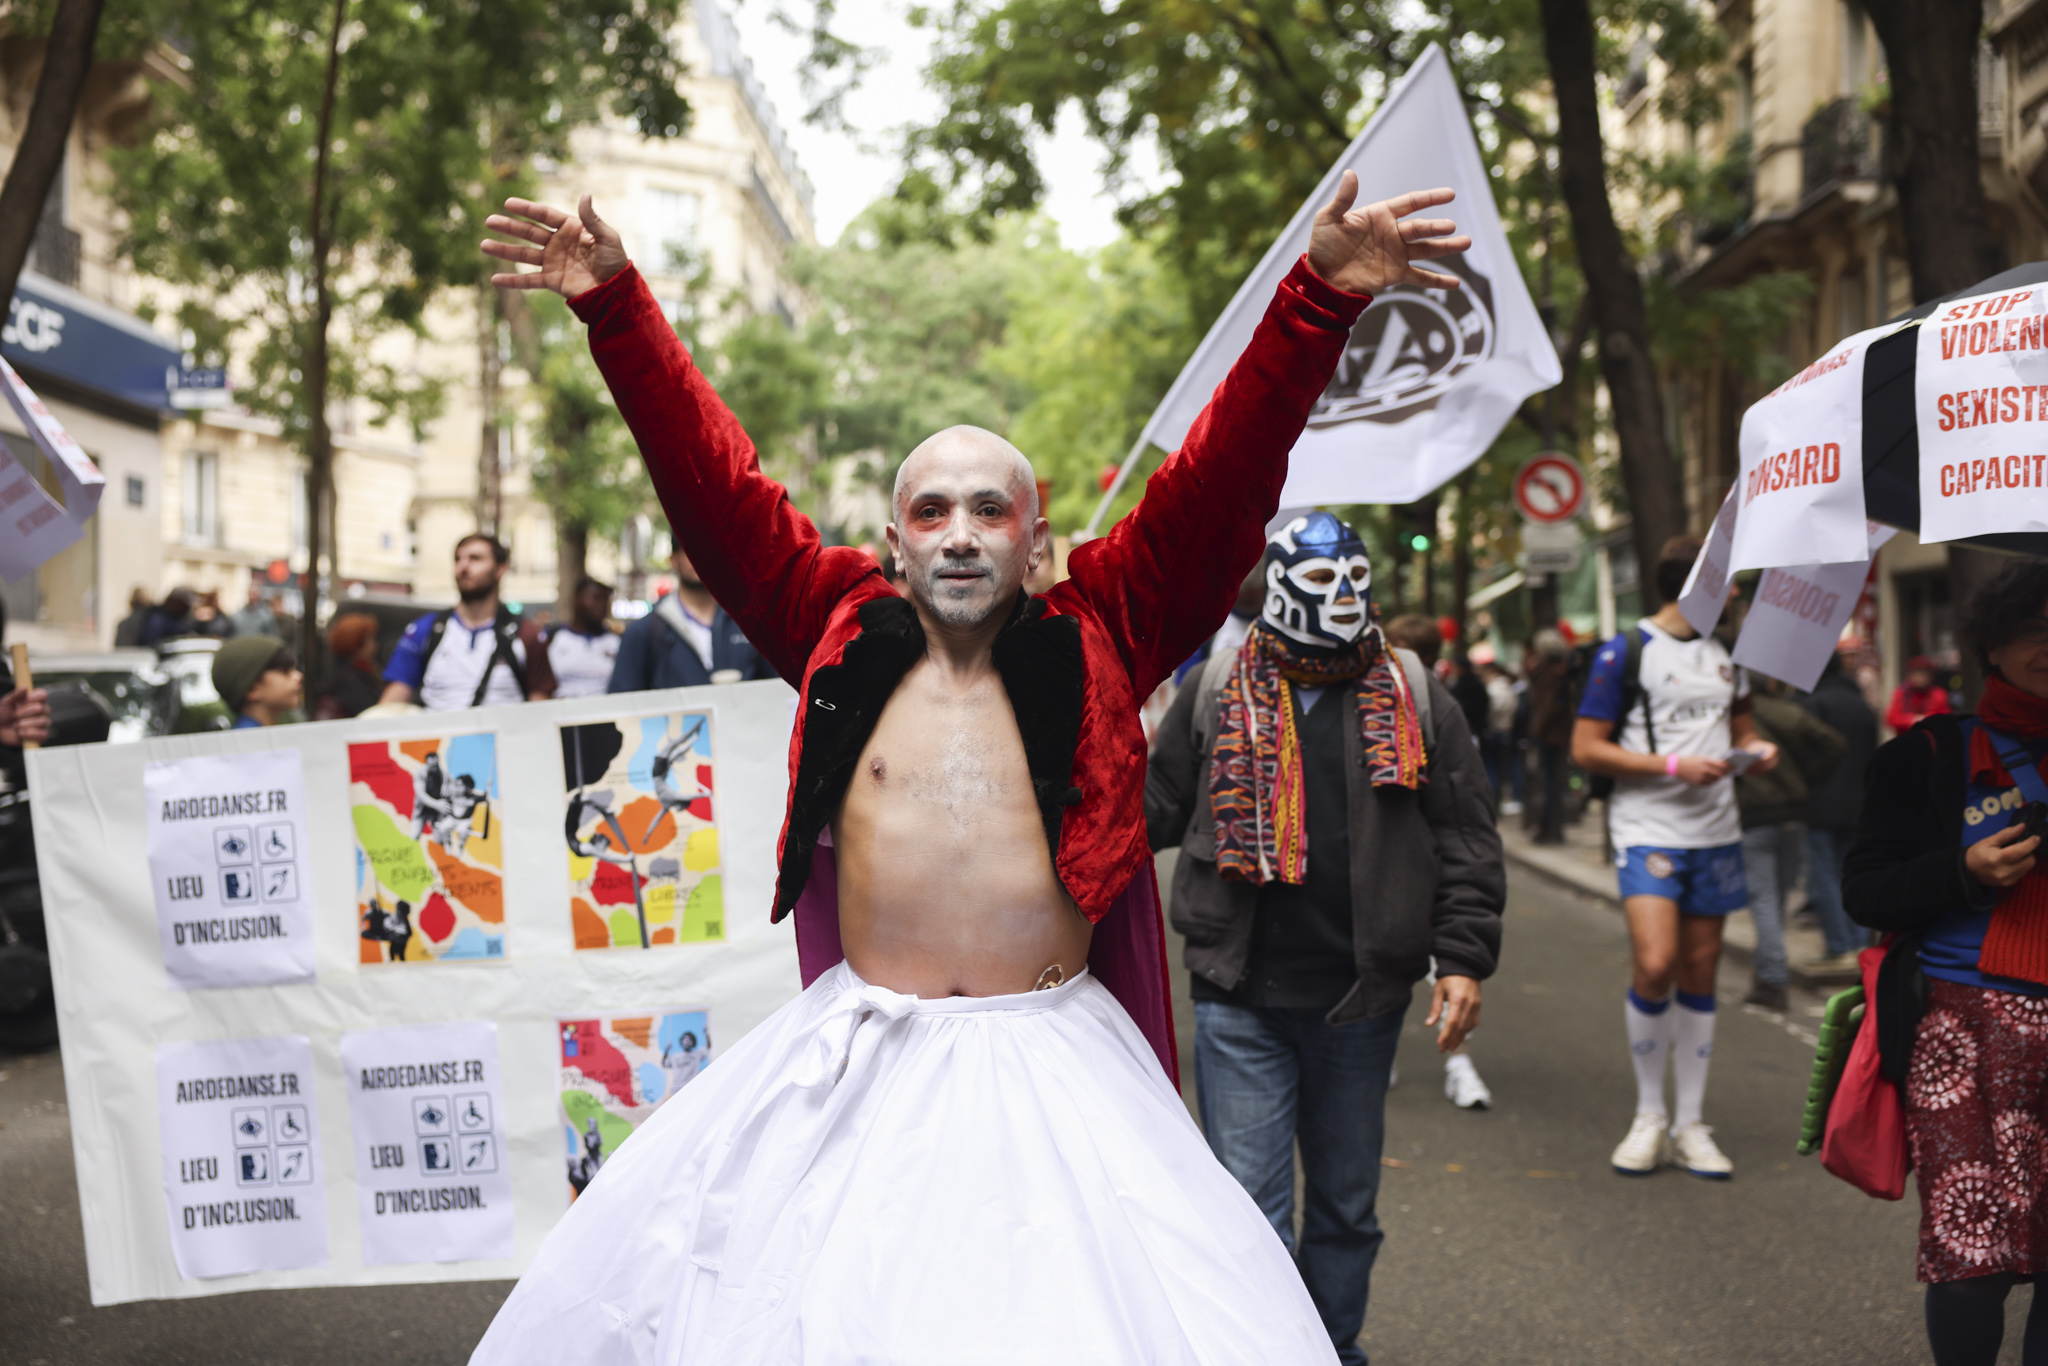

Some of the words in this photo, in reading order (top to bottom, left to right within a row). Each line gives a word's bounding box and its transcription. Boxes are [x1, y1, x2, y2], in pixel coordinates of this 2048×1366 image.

[1941, 291, 2033, 321] STOP
[1941, 455, 2048, 497] CAPACIT
[162, 790, 288, 822] AIRDEDANSE.FR
[168, 875, 203, 900] LIEU
[173, 915, 289, 946] D'INCLUSION.
[176, 1073, 300, 1103] AIRDEDANSE.FR
[361, 1060, 485, 1090] AIRDEDANSE.FR
[180, 1157, 218, 1183] LIEU
[370, 1145, 405, 1170] LIEU
[183, 1197, 302, 1230] D'INCLUSION.
[375, 1186, 487, 1215] D'INCLUSION.
